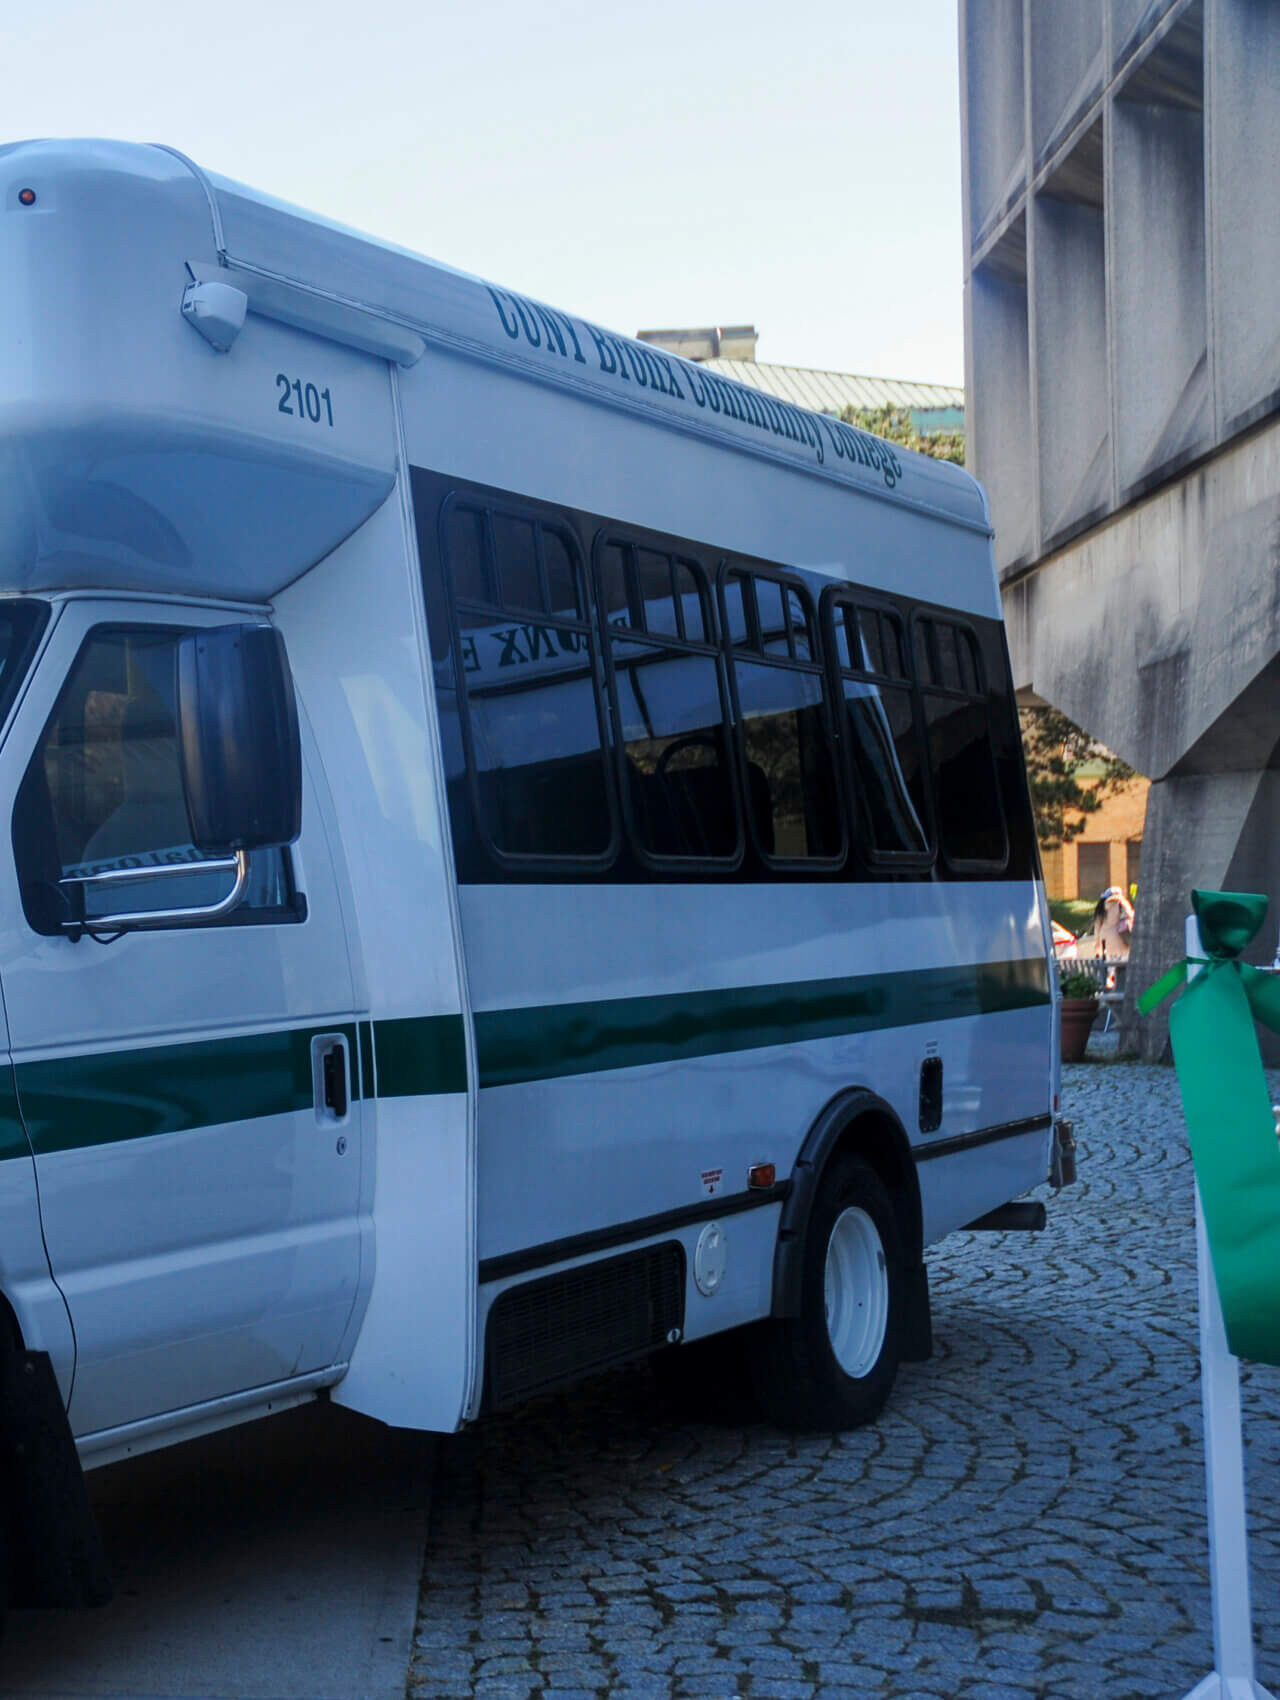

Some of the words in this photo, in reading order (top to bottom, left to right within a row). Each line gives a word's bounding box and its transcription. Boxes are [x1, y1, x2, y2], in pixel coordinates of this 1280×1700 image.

[276, 373, 334, 427] 2101
[485, 284, 586, 365] CUNY
[582, 322, 685, 400] Bronx
[678, 361, 824, 464] Community
[817, 414, 902, 488] College
